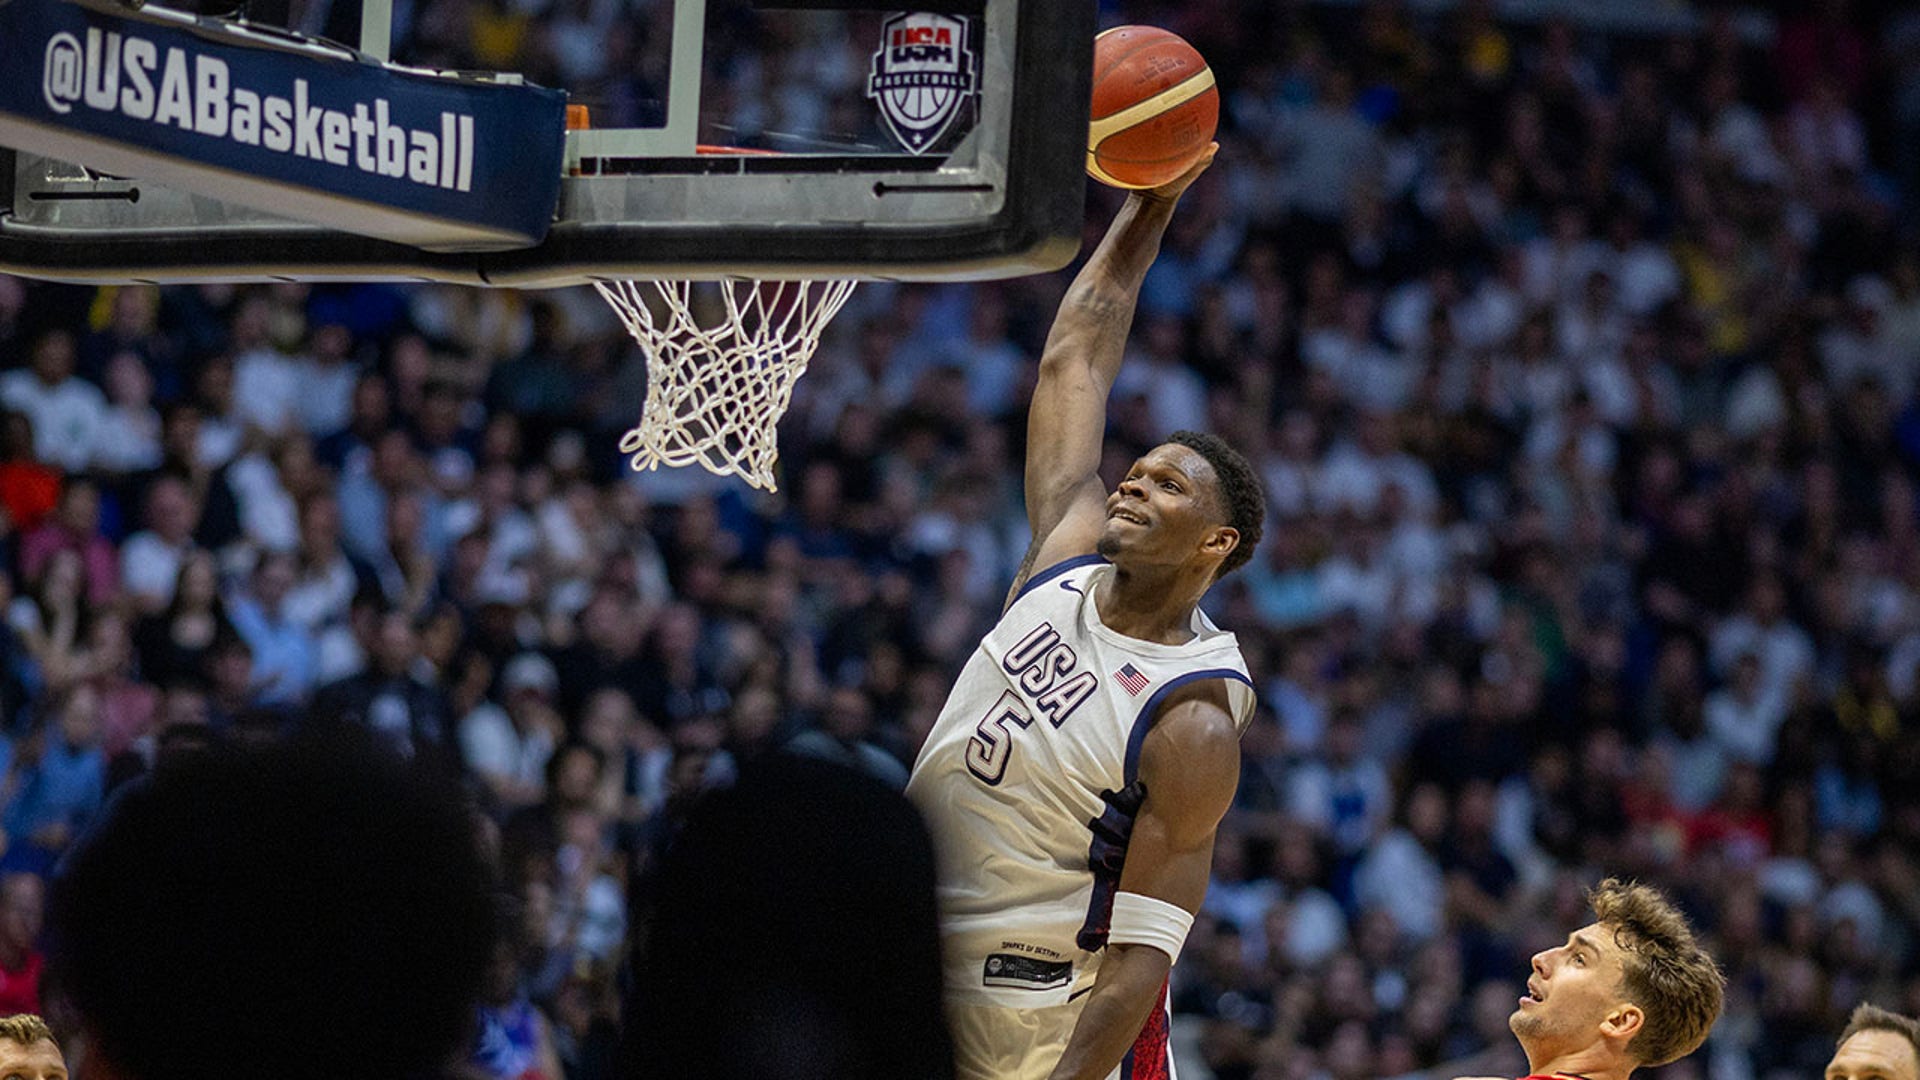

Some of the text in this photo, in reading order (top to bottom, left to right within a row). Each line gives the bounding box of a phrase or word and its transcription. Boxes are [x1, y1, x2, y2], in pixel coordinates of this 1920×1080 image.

[874, 74, 966, 88] BASKETBALL
[893, 27, 953, 63] USA
[43, 27, 475, 192] @USABasketball
[1003, 621, 1098, 729] USA
[965, 688, 1034, 786] 5
